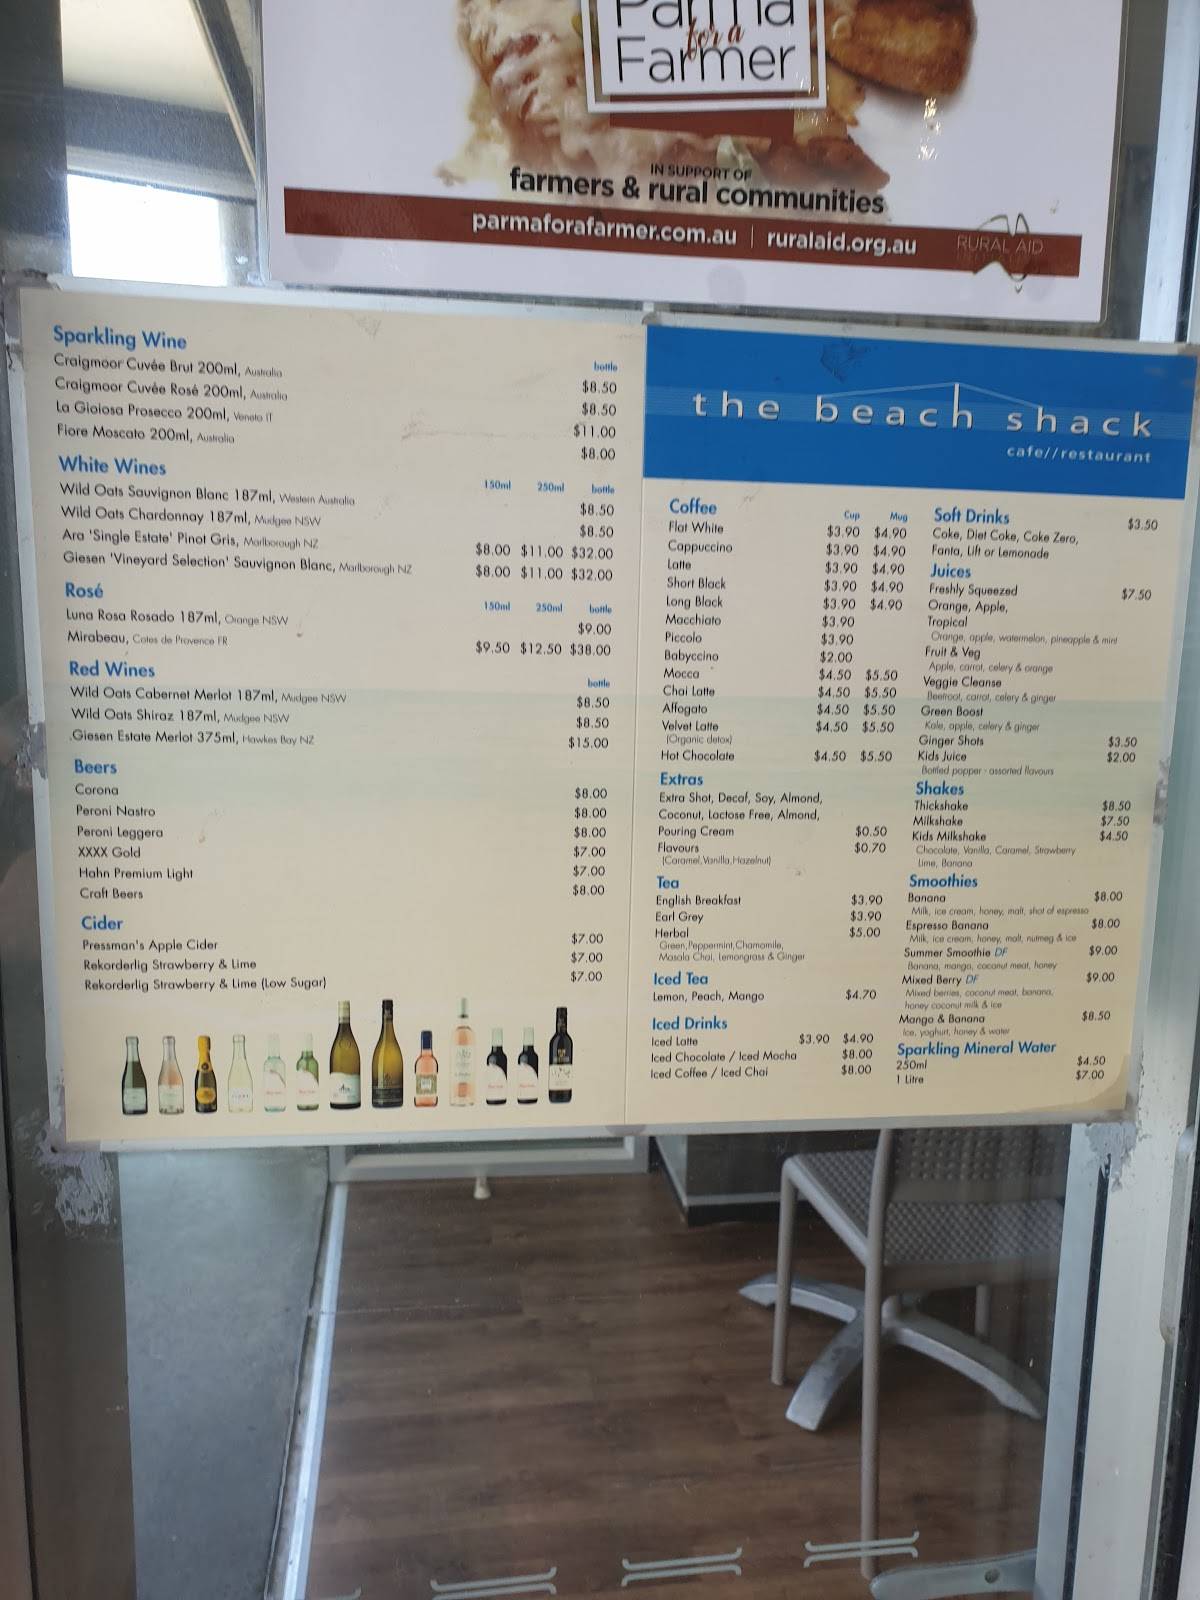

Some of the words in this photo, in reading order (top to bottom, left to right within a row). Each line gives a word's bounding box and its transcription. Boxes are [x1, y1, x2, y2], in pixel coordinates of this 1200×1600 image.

[616, 0, 794, 28] Parma
[687, 17, 722, 61] for
[727, 23, 744, 45] a
[617, 36, 796, 83] Farmer
[650, 163, 665, 175] IN
[667, 164, 730, 180] SUPPORT
[733, 168, 752, 181] OF
[510, 166, 614, 199] farmers
[622, 176, 640, 200] &
[648, 179, 708, 205] rural
[715, 183, 885, 215] communities
[471, 210, 737, 246] parmaforafarmer.com.au
[766, 229, 918, 257] ruralaid.org.au
[957, 235, 1010, 254] RURAL
[1015, 240, 1044, 255] AID
[53, 324, 136, 351] Sparkling
[142, 330, 187, 349] Wine
[53, 352, 124, 371] Craigmoor
[126, 357, 166, 372] Cuvée
[170, 359, 193, 373] Brut
[198, 361, 240, 377] 200ml,
[244, 366, 283, 378] Australia
[582, 379, 617, 394] $8.50
[594, 360, 618, 372] bottle
[56, 400, 70, 413] La
[74, 400, 123, 416] Gioiosa
[128, 403, 182, 418] Prosecco
[187, 406, 229, 422] 200ml,
[574, 423, 616, 439] $11.00
[692, 390, 780, 421] the
[815, 382, 974, 430] beach
[1006, 403, 1152, 439] shack
[1006, 445, 1152, 464] cafe//restaurant
[58, 454, 109, 473] White
[114, 458, 166, 475] Wines
[485, 480, 511, 490] 150ml
[537, 481, 565, 493] 250ml
[591, 483, 615, 494] bottle
[59, 482, 90, 496] Wild
[94, 483, 124, 497] Oats
[128, 484, 191, 502] Sauvignon
[196, 487, 228, 500] Blanc
[235, 488, 275, 504] 187ml,
[279, 493, 315, 504] Western
[318, 494, 355, 506] Australia
[580, 502, 614, 517] $8.50
[669, 497, 717, 514] Coffee
[844, 510, 860, 522] Cup
[890, 512, 908, 523] Mug
[934, 506, 961, 522] Soft
[966, 508, 1009, 524] Drinks
[1128, 517, 1158, 531] $3.50
[669, 520, 688, 533] Flat
[691, 521, 724, 534] White
[827, 524, 860, 538] $3.90
[874, 526, 907, 540] $4.90
[932, 527, 962, 542] Coke,
[967, 528, 987, 540] Diet
[990, 529, 1019, 543] Coke,
[1023, 530, 1050, 543] Coke
[1053, 531, 1078, 546] Zero,
[668, 539, 733, 555] Cappuccino
[826, 542, 859, 556] $3.90
[873, 544, 906, 557] $4.90
[63, 550, 105, 564] Giesen
[110, 552, 167, 568] 'Vineyard
[172, 553, 229, 568] Selection'
[234, 556, 296, 573] Sauvignon
[300, 557, 335, 573] Blanc,
[339, 562, 395, 576] Marlborough
[397, 564, 412, 575] NZ
[476, 564, 511, 578] $8.00
[521, 565, 563, 580] $11.00
[571, 567, 613, 582] $32.00
[930, 563, 971, 578] Juices
[65, 581, 103, 598] Rosé
[929, 582, 964, 598] Freshly
[968, 584, 1018, 598] Squeezed
[1121, 587, 1152, 601] $7.50
[69, 659, 99, 676] Red
[104, 661, 155, 678] Wines
[929, 661, 956, 673] Apple,
[959, 663, 985, 673] carrot,
[988, 661, 1013, 675] celery
[1015, 662, 1022, 672] &
[1024, 665, 1053, 675] orange
[72, 728, 113, 741] Giesen
[117, 729, 151, 742] Estate
[155, 730, 193, 743] Merlot
[197, 731, 239, 745] 375ml,
[242, 734, 278, 744] Hawkes
[280, 734, 297, 746] Bay
[299, 735, 314, 745] NZ
[568, 736, 609, 749] $15.00
[666, 733, 704, 746] (Organic
[706, 733, 732, 745] detox)
[74, 758, 117, 774] Beers
[660, 772, 703, 786] Extras
[916, 780, 964, 796] Shakes
[76, 804, 112, 816] Peroni
[116, 805, 156, 817] Nastro
[574, 806, 607, 820] $8.00
[913, 814, 963, 826] Milkshake
[1101, 815, 1130, 827] $7.50
[658, 825, 697, 839] Pouring
[700, 825, 734, 837] Cream
[855, 825, 888, 838] $0.50
[79, 866, 110, 878] Hahn
[114, 867, 163, 879] Premium
[167, 867, 193, 882] Light
[573, 864, 606, 877] $7.00
[909, 873, 978, 888] Smoothies
[657, 876, 679, 889] Tea
[656, 894, 691, 908] English
[695, 894, 741, 905] Breakfast
[851, 894, 883, 906] $3.90
[908, 892, 946, 903] Banana
[1094, 890, 1123, 903] $8.00
[81, 915, 123, 930] Cider
[82, 939, 145, 951] Pressman's
[148, 938, 182, 953] Apple
[186, 938, 217, 950] Cider
[571, 932, 604, 945] $7.00
[904, 947, 943, 958] Summer
[946, 946, 991, 958] Smoothie
[994, 947, 1008, 958] DF
[1089, 945, 1118, 957] $9.00
[84, 978, 149, 993] Rekorderlig
[153, 978, 215, 992] Strawberry
[219, 978, 228, 989] &
[232, 978, 257, 989] Lime
[261, 977, 287, 991] (Low
[290, 976, 326, 991] Sugar)
[571, 970, 603, 983] $7.00
[652, 1016, 680, 1030] Iced
[685, 1015, 728, 1030] Drinks
[897, 1041, 960, 1059] Sparkling
[964, 1040, 1014, 1054] Mineral
[1018, 1041, 1056, 1053] Water
[896, 1058, 927, 1070] 250ml
[1077, 1055, 1106, 1067] $4.50
[650, 1067, 672, 1079] Iced
[674, 1066, 708, 1079] Coffee
[710, 1066, 718, 1080] /
[721, 1066, 741, 1078] Iced
[744, 1065, 768, 1077] Chai
[841, 1064, 872, 1076] $8.00
